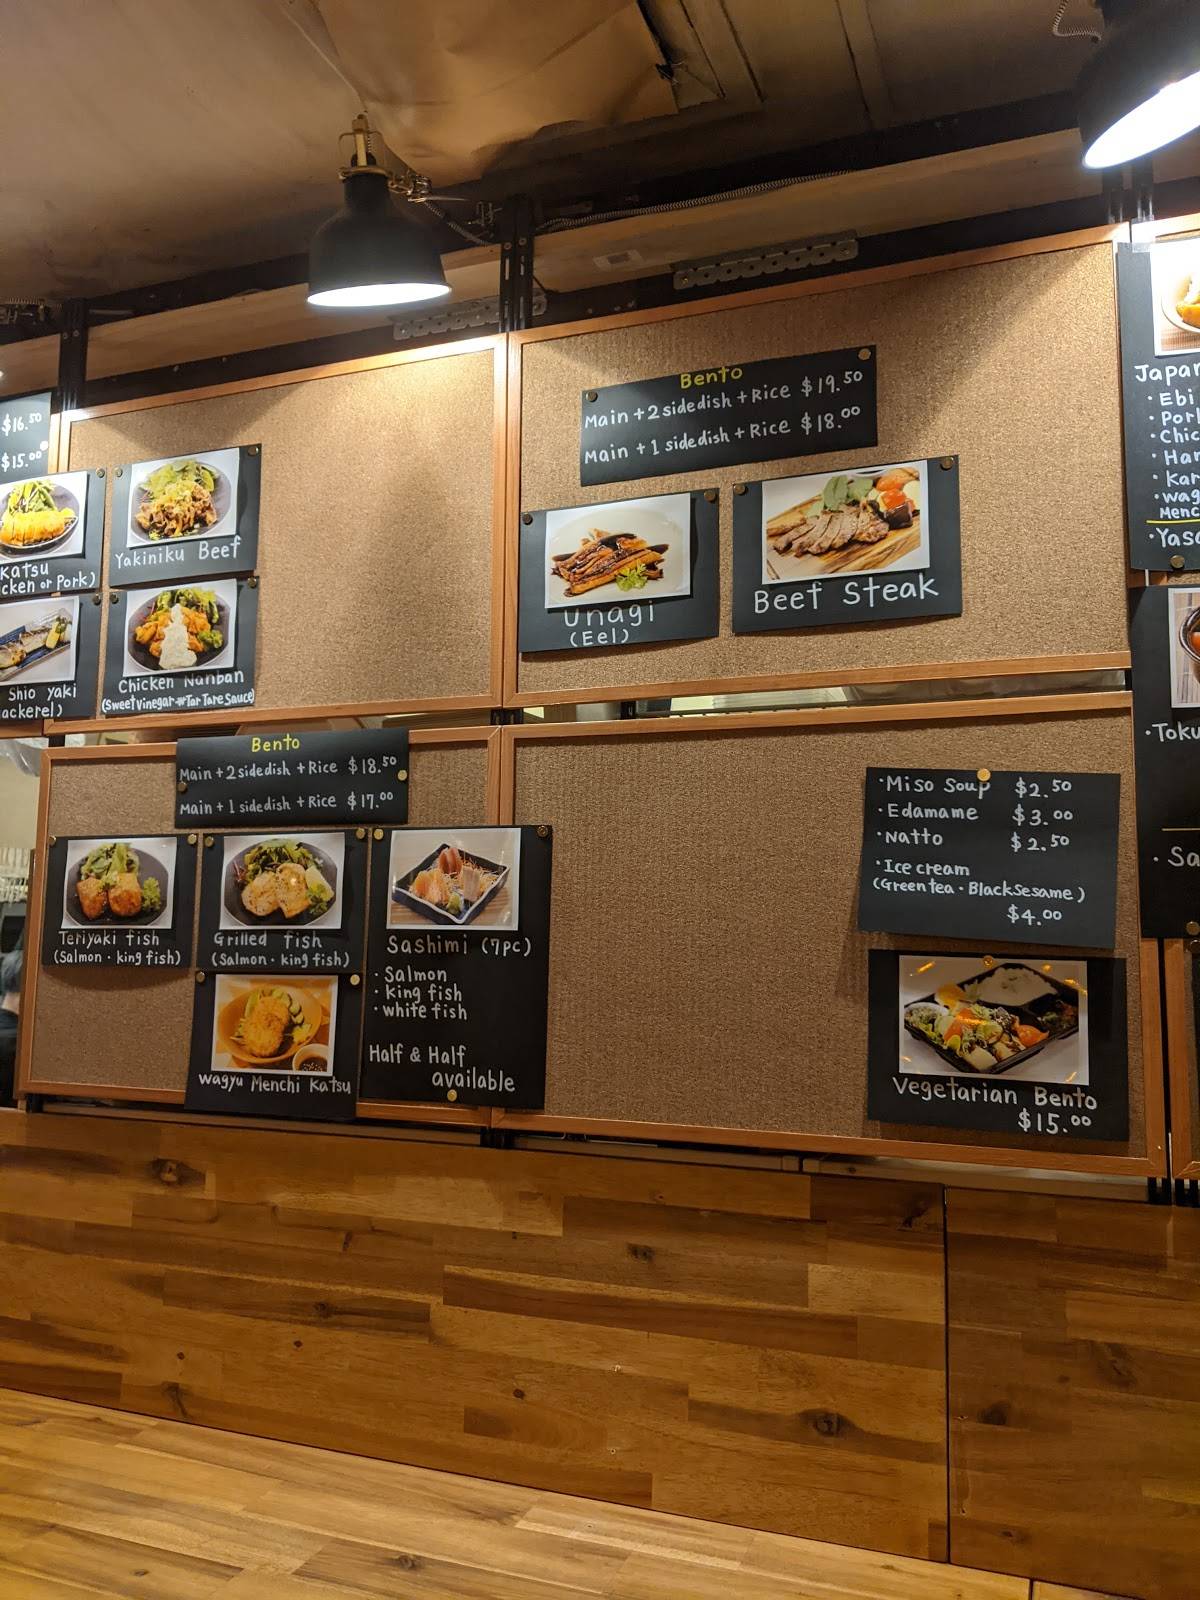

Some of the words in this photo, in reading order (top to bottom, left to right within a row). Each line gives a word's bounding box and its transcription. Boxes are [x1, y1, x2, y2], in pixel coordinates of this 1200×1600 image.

[680, 365, 743, 389] Bento
[584, 409, 629, 429] Main
[801, 370, 863, 397] $19.50
[1159, 388, 1194, 406] Ebi
[1, 412, 42, 437] $16.50
[584, 445, 629, 465] Main
[801, 405, 861, 435] $18.00
[1160, 427, 1200, 443] Chic
[1, 451, 42, 473] $15.00
[1160, 506, 1200, 519] Menc
[115, 547, 185, 569] Yakiniku
[199, 536, 241, 559] Beef
[40, 578, 53, 589] or
[57, 572, 96, 591] Pork)
[754, 581, 823, 614] Beef
[843, 572, 939, 608] Steak
[564, 600, 654, 627] Unagi
[570, 627, 629, 647] (Eel)
[118, 676, 174, 694] Chicken
[184, 670, 244, 688] Nanban
[8, 685, 36, 701] Shio
[224, 688, 255, 706] Sauce)
[1, 701, 63, 719] ackerel)
[252, 733, 300, 752] Bento
[179, 765, 212, 782] Main
[348, 755, 397, 775] $18.50
[886, 775, 934, 792] Miso
[944, 778, 991, 799] Soup
[1015, 777, 1072, 798] $2.50
[180, 800, 212, 816] Main
[347, 791, 393, 811] $17.00
[888, 803, 979, 820] Edamame
[1012, 804, 1073, 826] $3.00
[1011, 832, 1070, 852] $2.50
[884, 859, 912, 875] Ice
[916, 863, 970, 876] cream
[1007, 904, 1062, 925] $4.00
[59, 930, 116, 949] Teriyaki
[126, 930, 159, 946] fish
[214, 931, 267, 946] Grilled
[284, 930, 322, 949] fish
[387, 934, 467, 955] Sashimi
[481, 937, 531, 956] (7pc)
[54, 949, 102, 964] (Salmon
[146, 950, 181, 966] fish)
[211, 952, 267, 967] (Salmon
[312, 951, 350, 968] fish)
[384, 965, 447, 983] Salmon
[428, 983, 462, 1001] fish
[383, 1002, 427, 1019] white
[431, 1003, 467, 1020] fish
[369, 1043, 403, 1063] Half
[409, 1046, 421, 1063] &
[429, 1045, 466, 1067] Half
[251, 1075, 300, 1093] Menchi
[432, 1067, 515, 1092] available
[892, 1076, 1017, 1105] Vegetarian
[1034, 1086, 1097, 1110] Bento
[1018, 1108, 1091, 1134] $15.00
